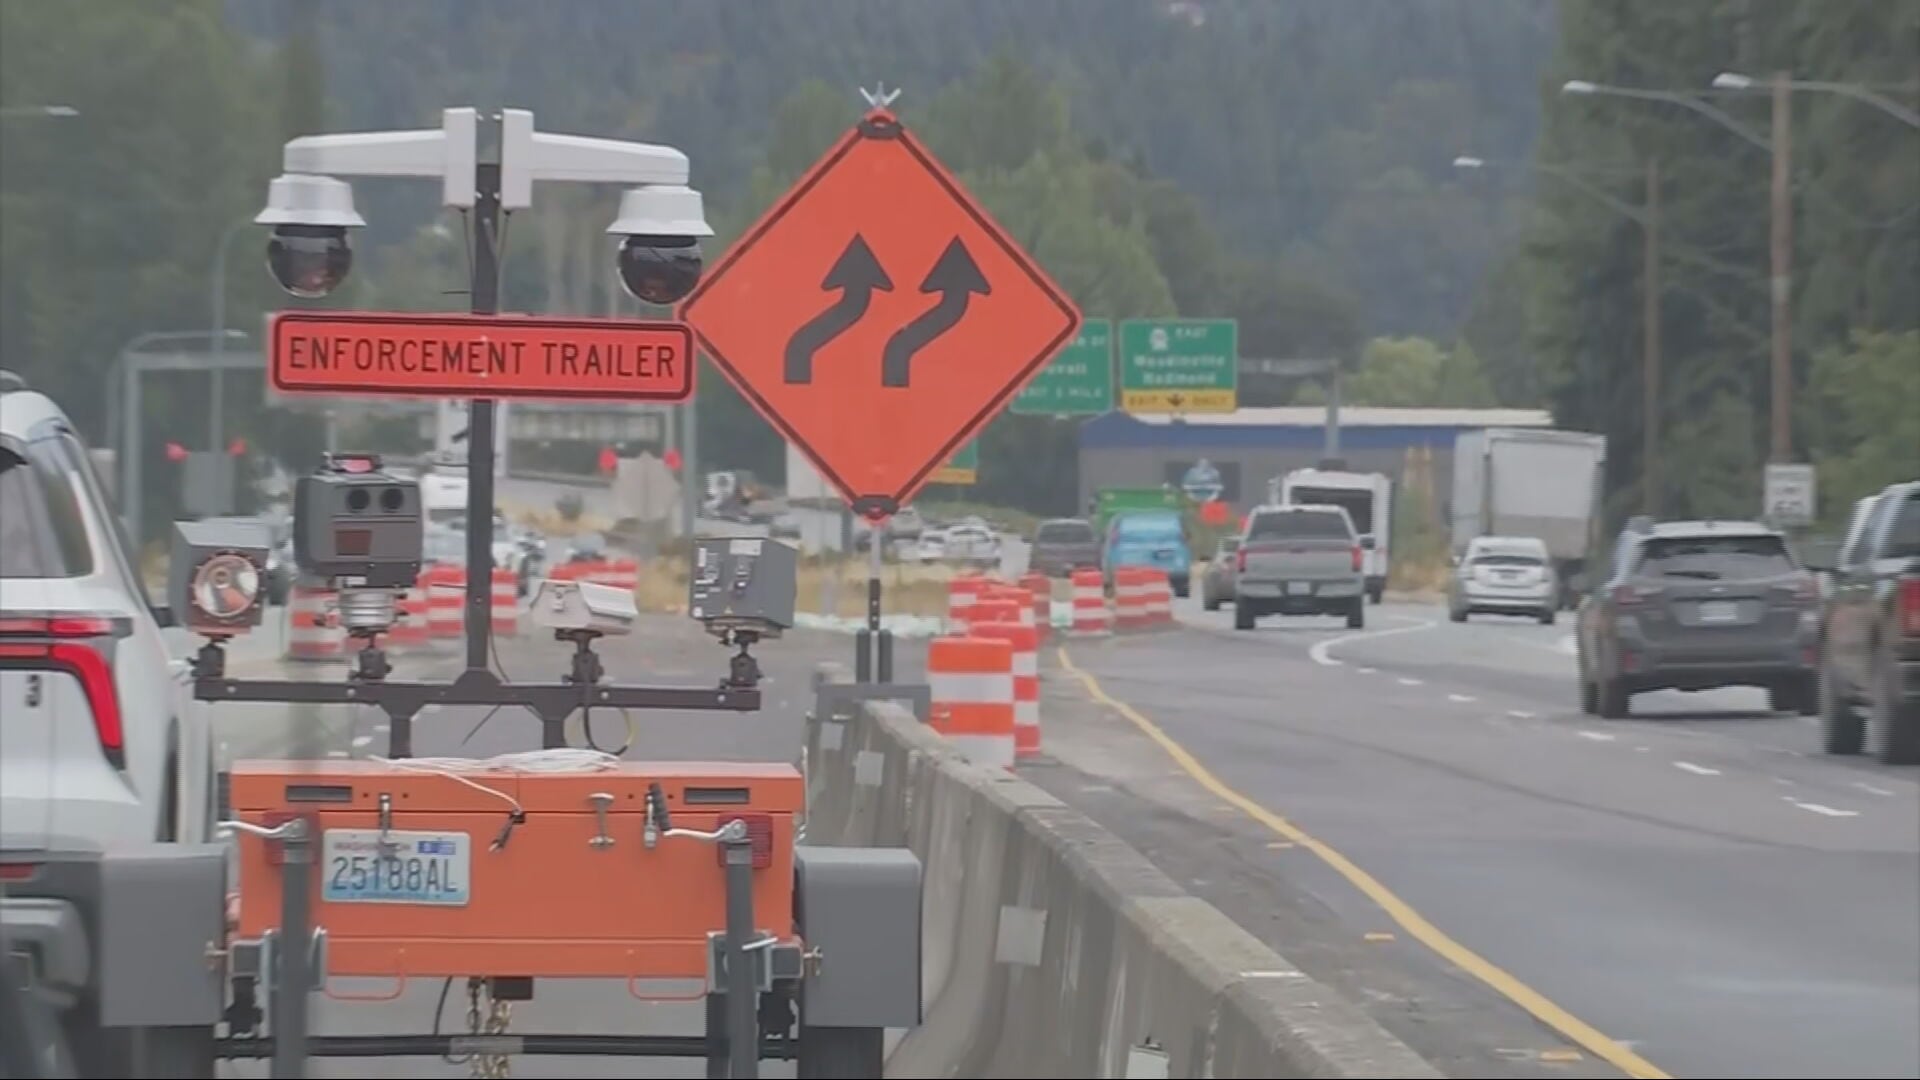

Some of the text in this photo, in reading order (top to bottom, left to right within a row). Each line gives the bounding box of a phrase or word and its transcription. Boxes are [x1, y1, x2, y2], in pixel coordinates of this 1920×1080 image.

[1175, 327, 1209, 340] EAST
[289, 336, 675, 378] ENFORCEMENT TRAILER
[1143, 371, 1216, 385] Redmond
[1069, 386, 1103, 399] MILE
[1129, 395, 1227, 405] EXIT ONLY
[331, 856, 457, 893] 25188AL
